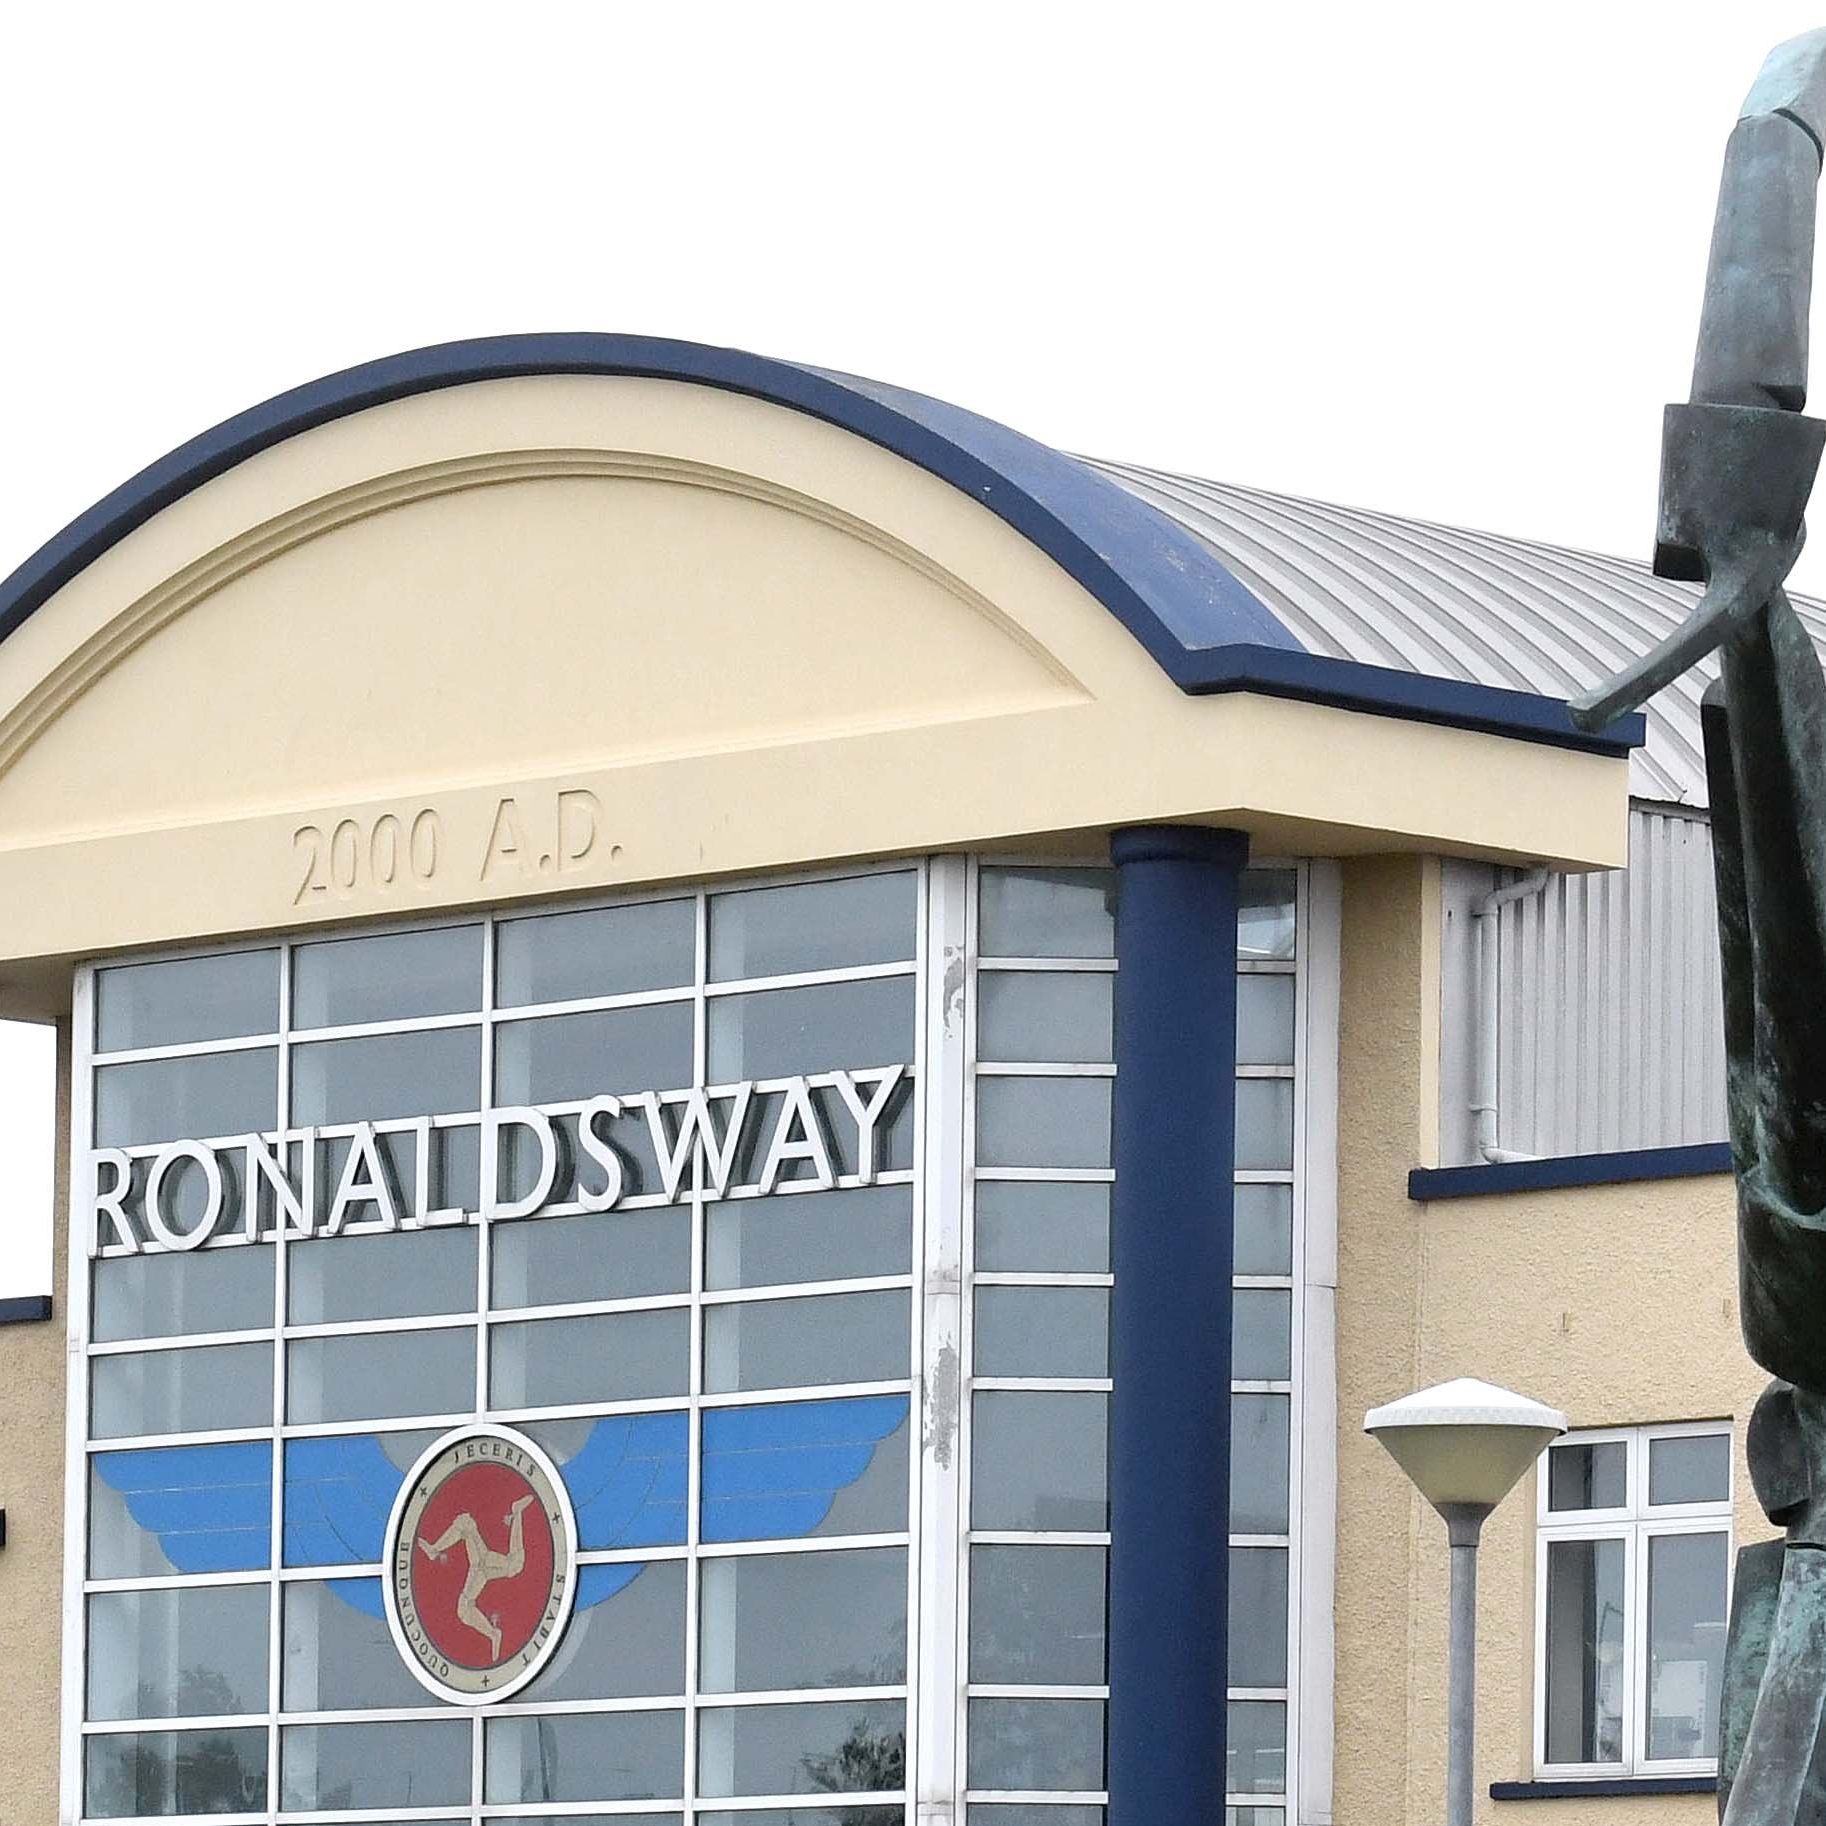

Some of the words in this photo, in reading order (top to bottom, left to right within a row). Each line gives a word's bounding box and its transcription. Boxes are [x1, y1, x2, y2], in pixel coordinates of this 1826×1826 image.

[293, 808, 443, 905] 2000
[480, 788, 624, 881] A.D.
[88, 1064, 906, 1258] RONALDSWAY
[453, 1442, 536, 1478] JECERIS
[523, 1574, 566, 1667] STABIT
